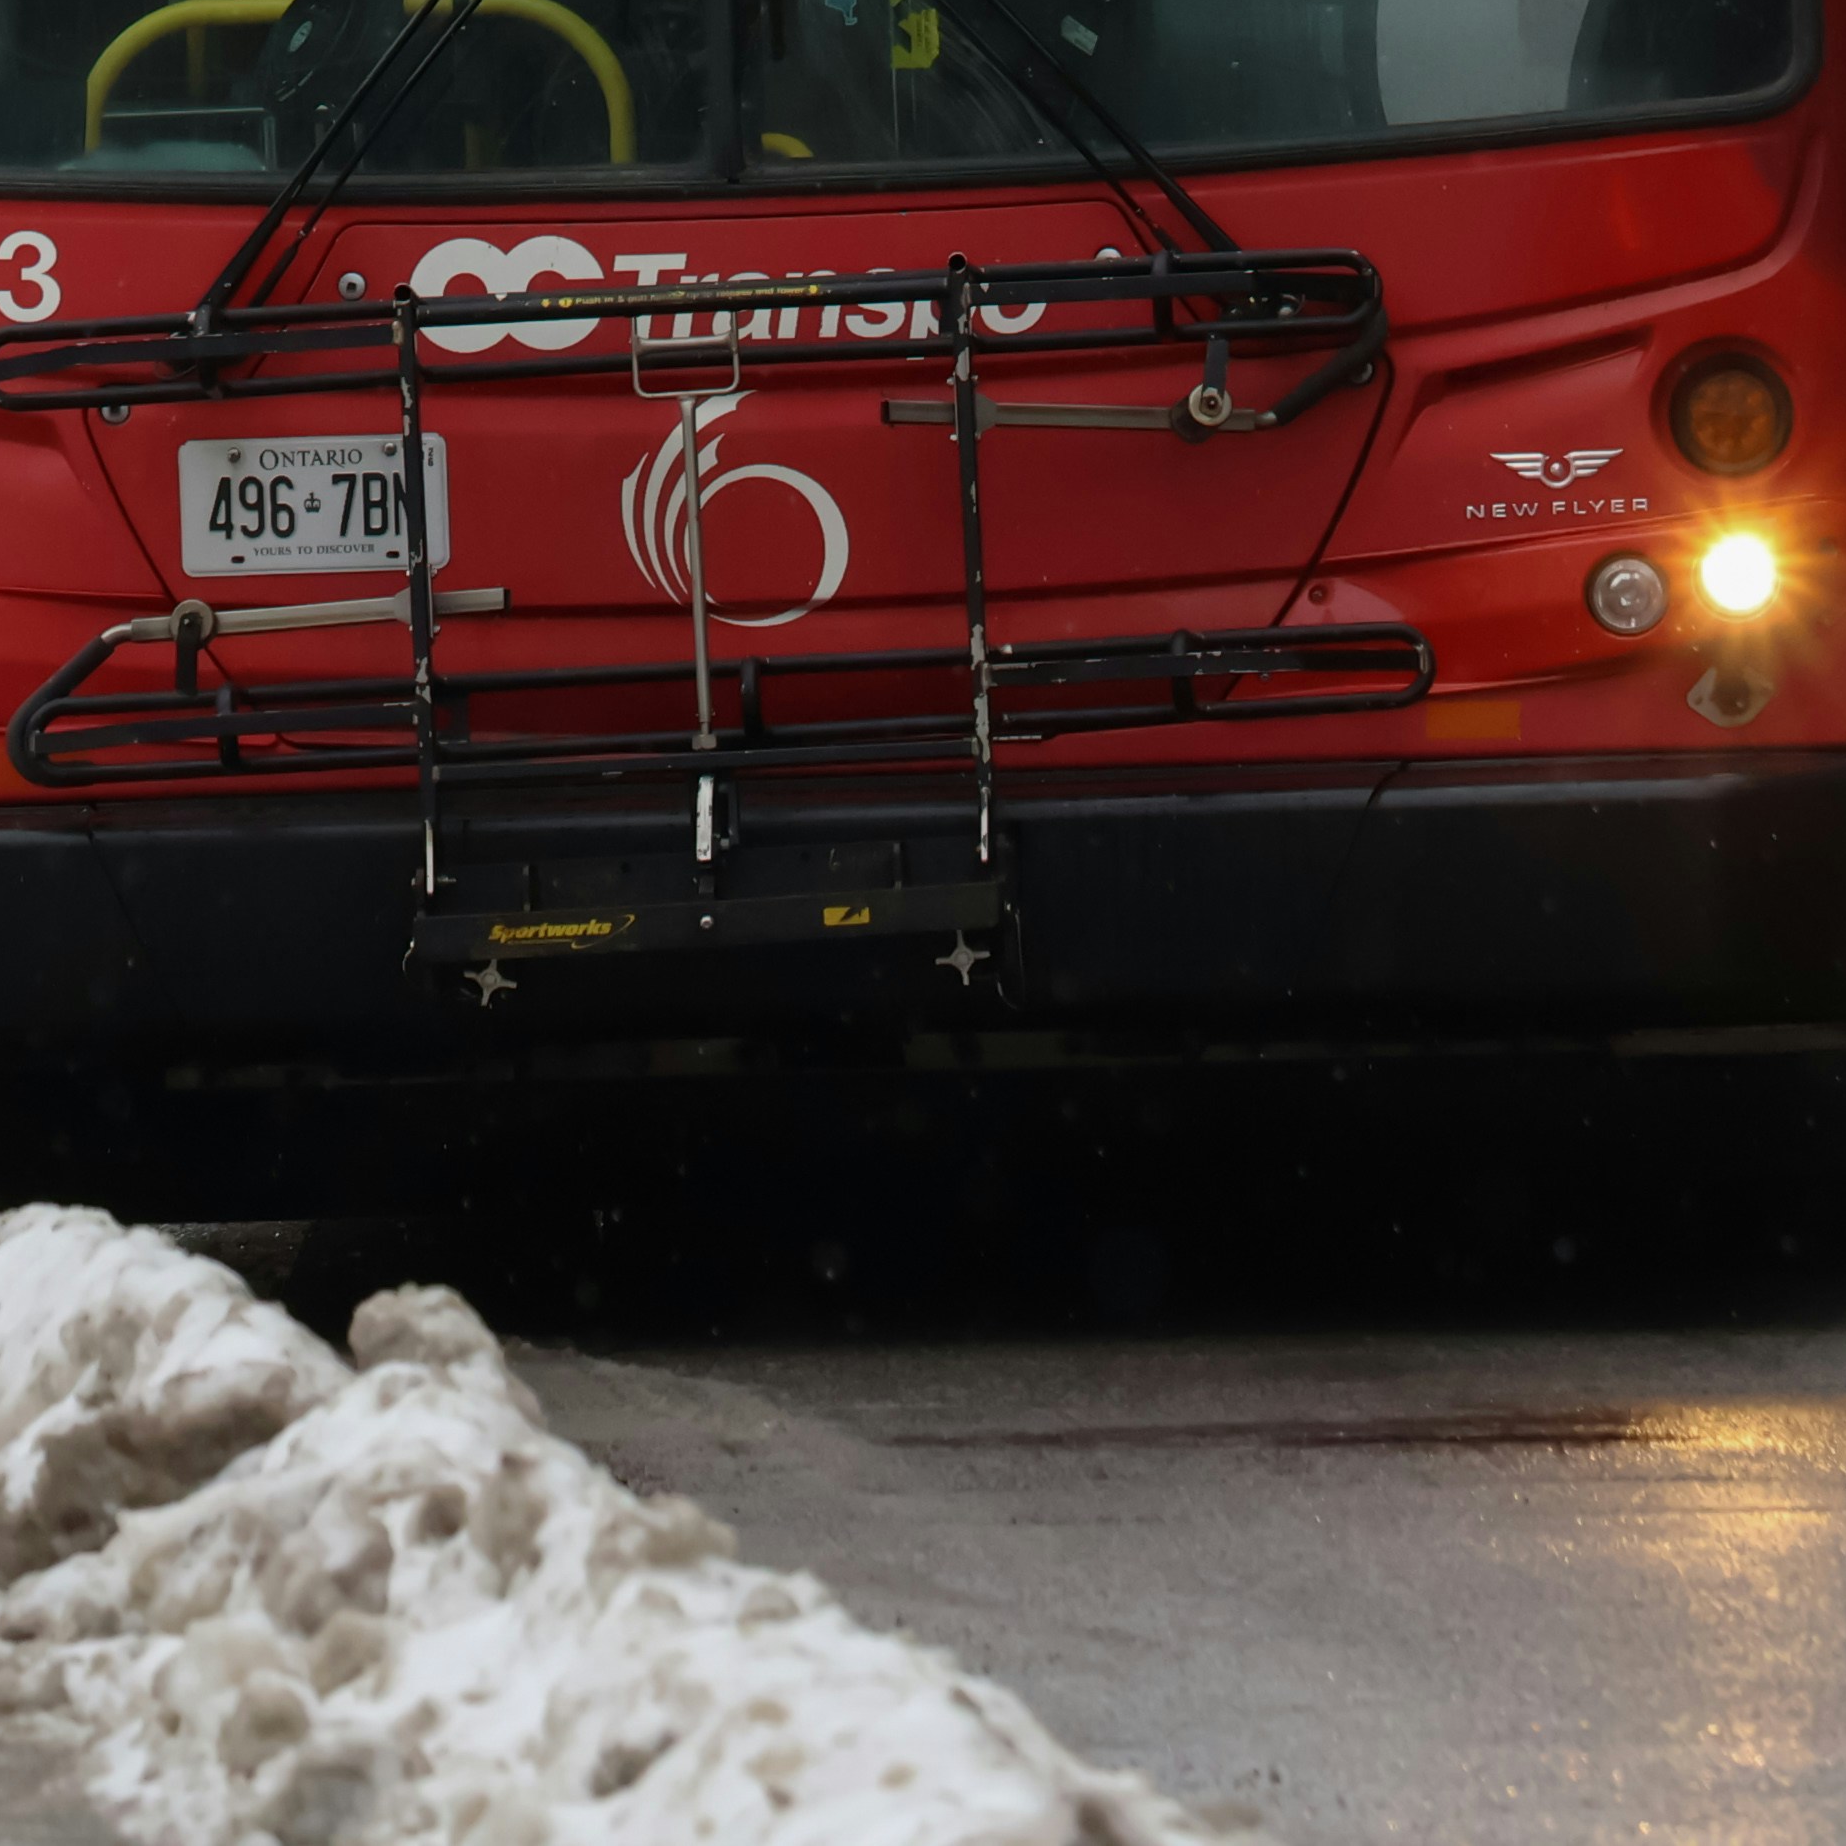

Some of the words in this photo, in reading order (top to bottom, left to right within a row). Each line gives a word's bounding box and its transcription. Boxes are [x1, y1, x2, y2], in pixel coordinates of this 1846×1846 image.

[259, 448, 363, 471] ONTARIO
[209, 475, 295, 541] 496
[1465, 501, 1540, 519] NEW
[1550, 497, 1651, 516] FLYER
[254, 543, 292, 557] YOURS
[297, 543, 313, 556] TO
[316, 542, 375, 555] DISCOVER
[489, 918, 613, 944] Sportworks
